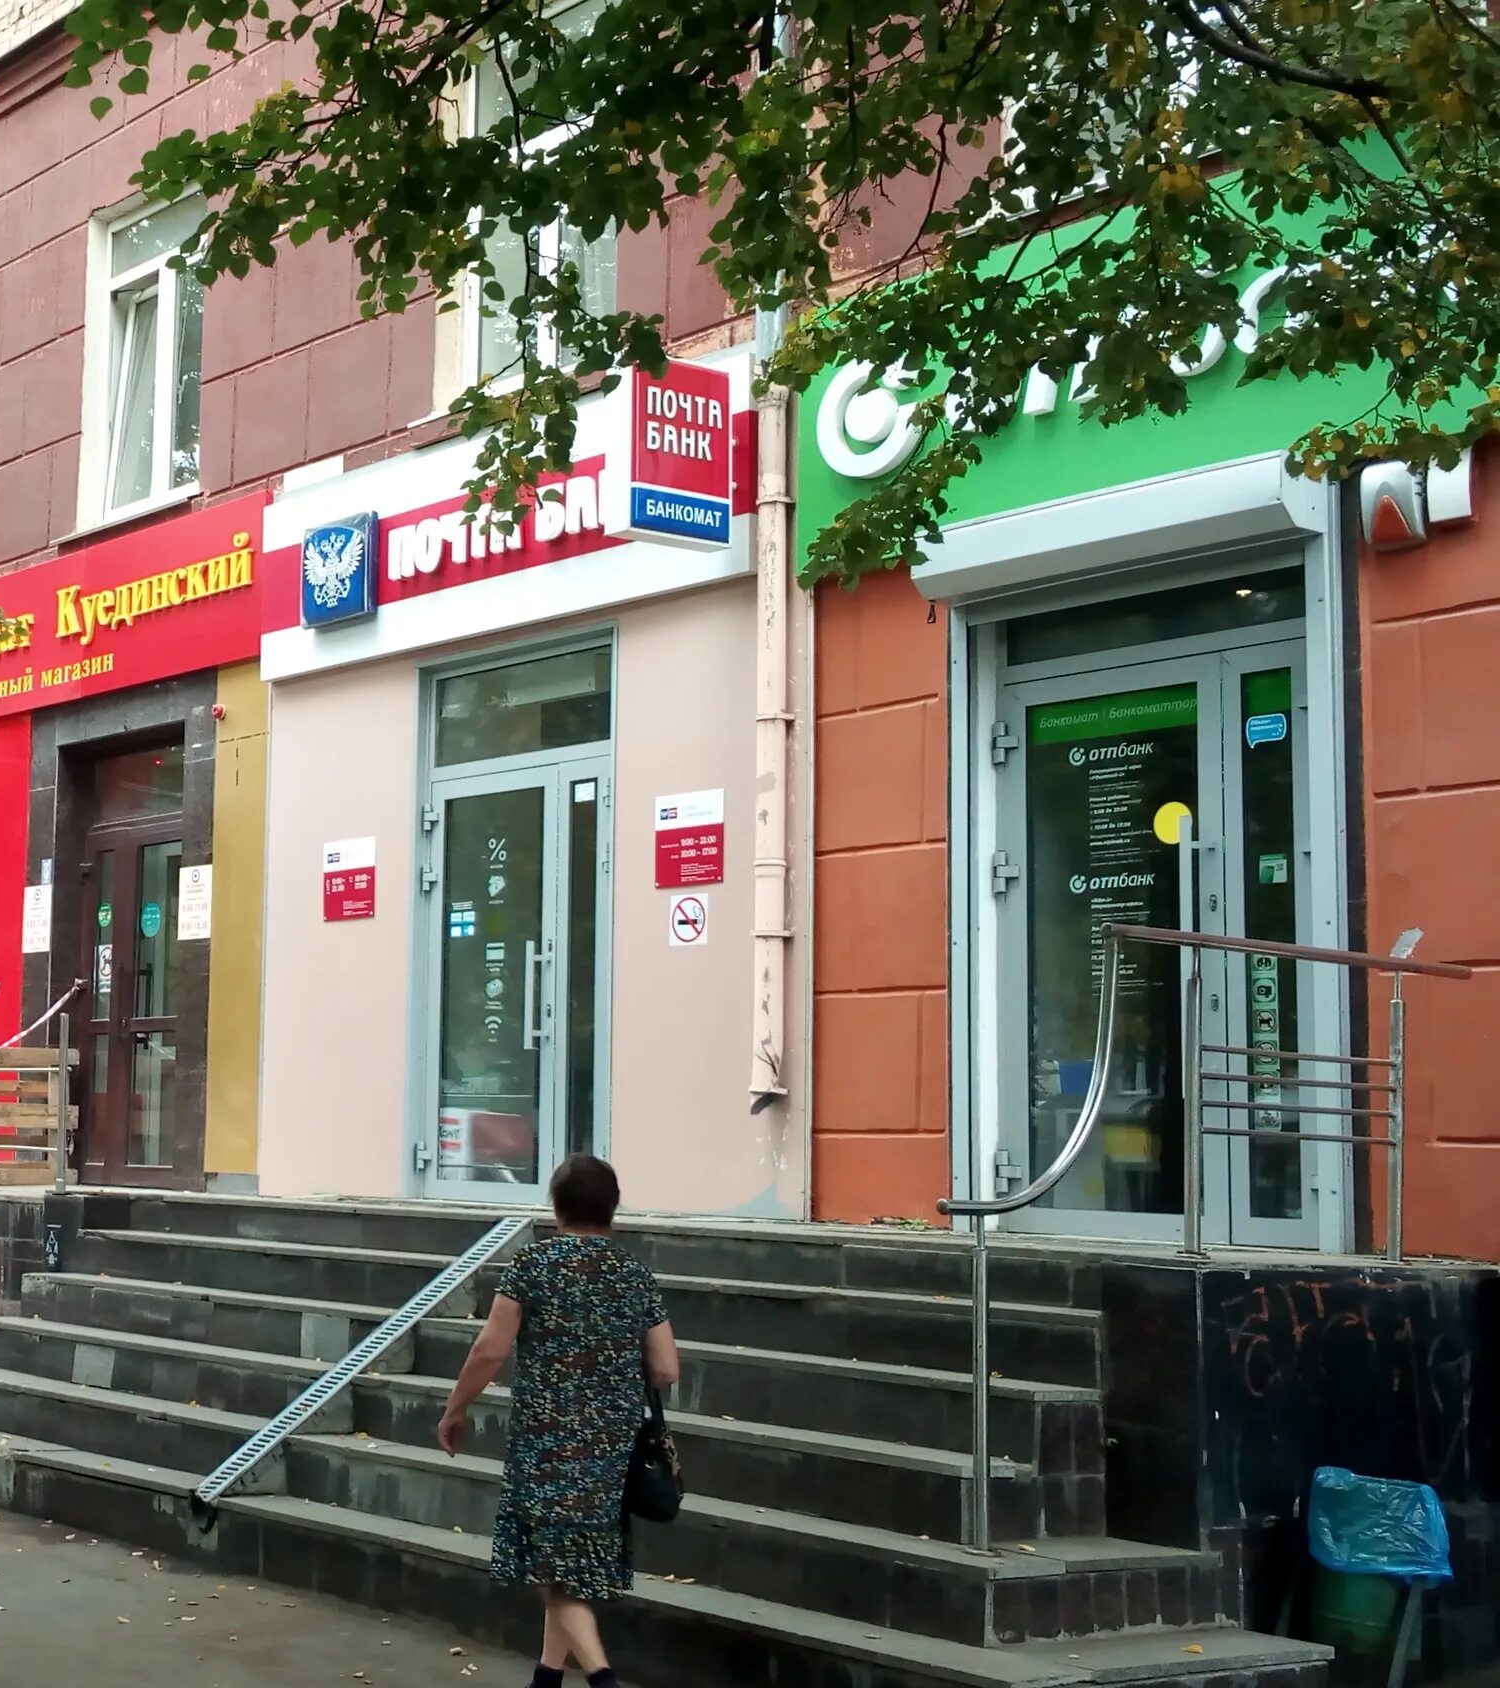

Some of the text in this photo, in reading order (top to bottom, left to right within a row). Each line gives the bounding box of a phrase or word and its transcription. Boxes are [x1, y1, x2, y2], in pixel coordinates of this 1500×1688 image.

[646, 385, 723, 430] ПОЧТА
[646, 420, 713, 462] БАНК
[646, 498, 723, 528] БАНКОМАТ
[55, 532, 254, 646] Куединский
[40, 652, 115, 690] магазин
[1039, 711, 1099, 729] Банкомат
